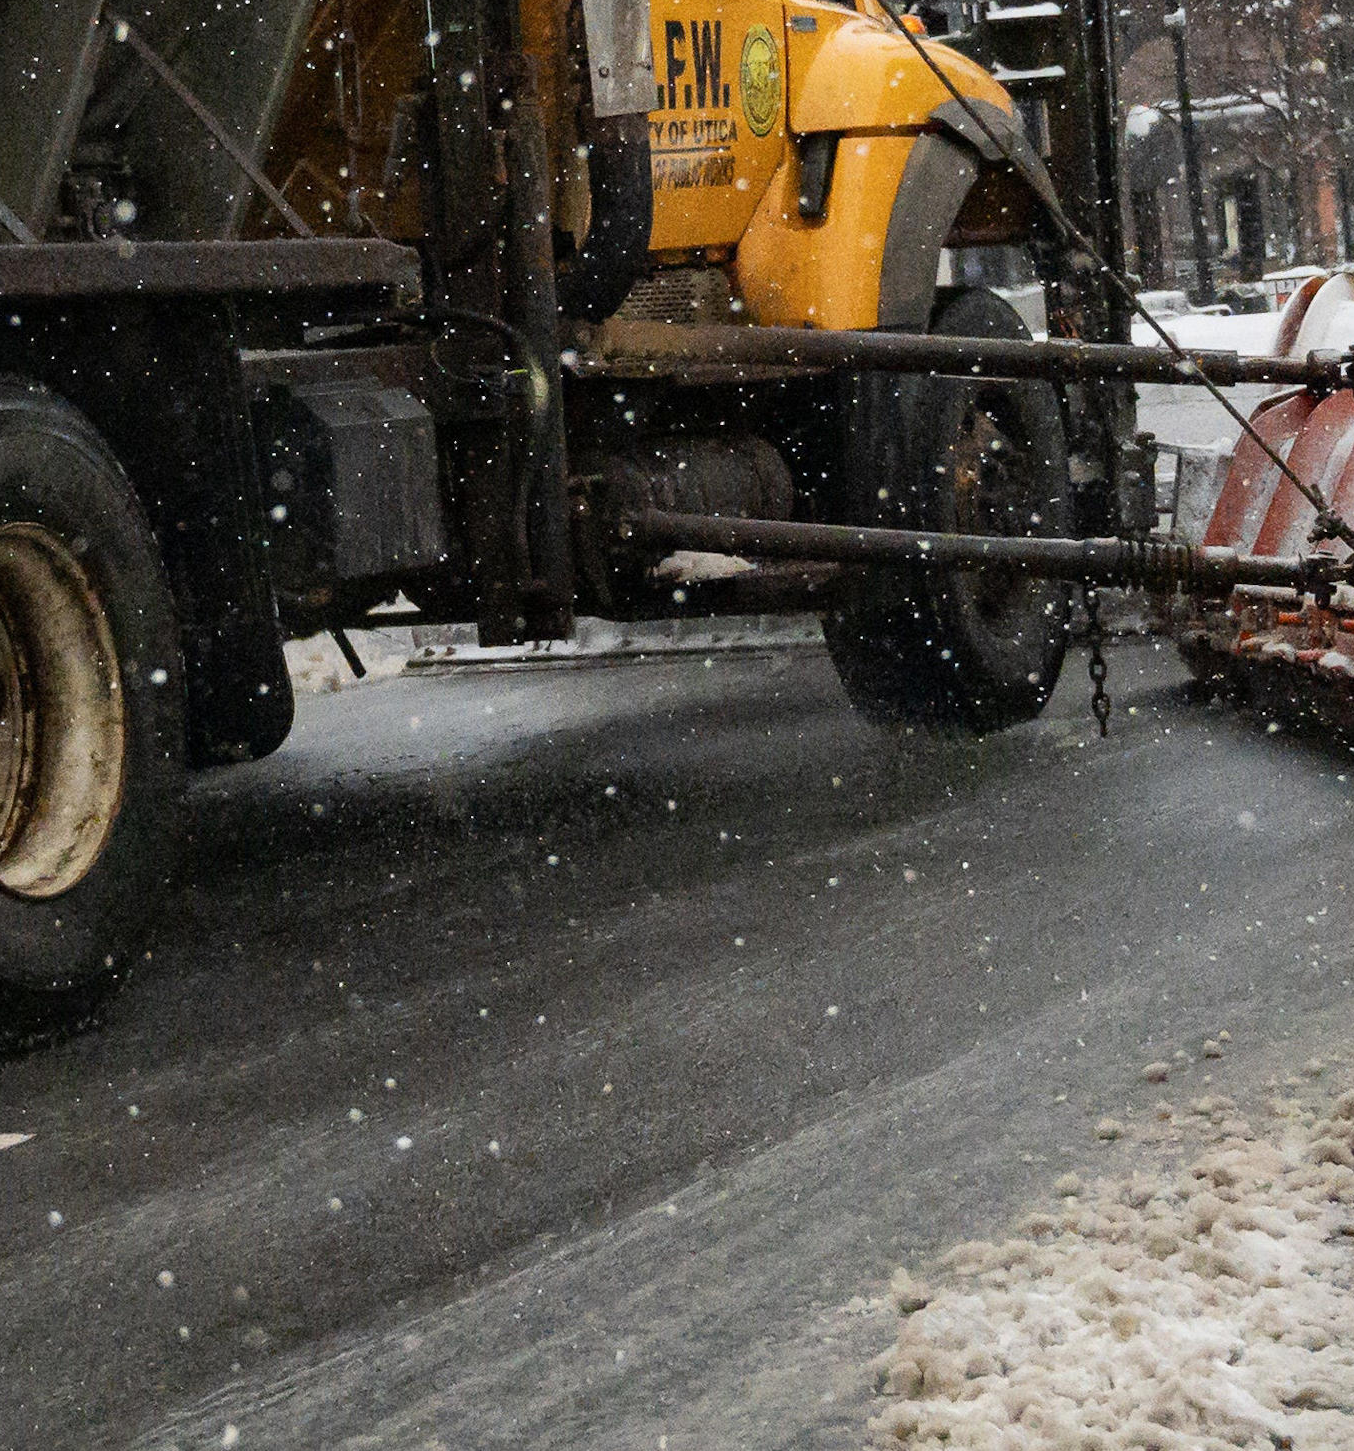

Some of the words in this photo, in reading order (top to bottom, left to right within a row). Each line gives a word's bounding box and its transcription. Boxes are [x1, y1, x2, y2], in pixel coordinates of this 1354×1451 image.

[657, 20, 730, 109] .P.W.
[668, 120, 687, 145] OF
[693, 118, 738, 144] UTICA
